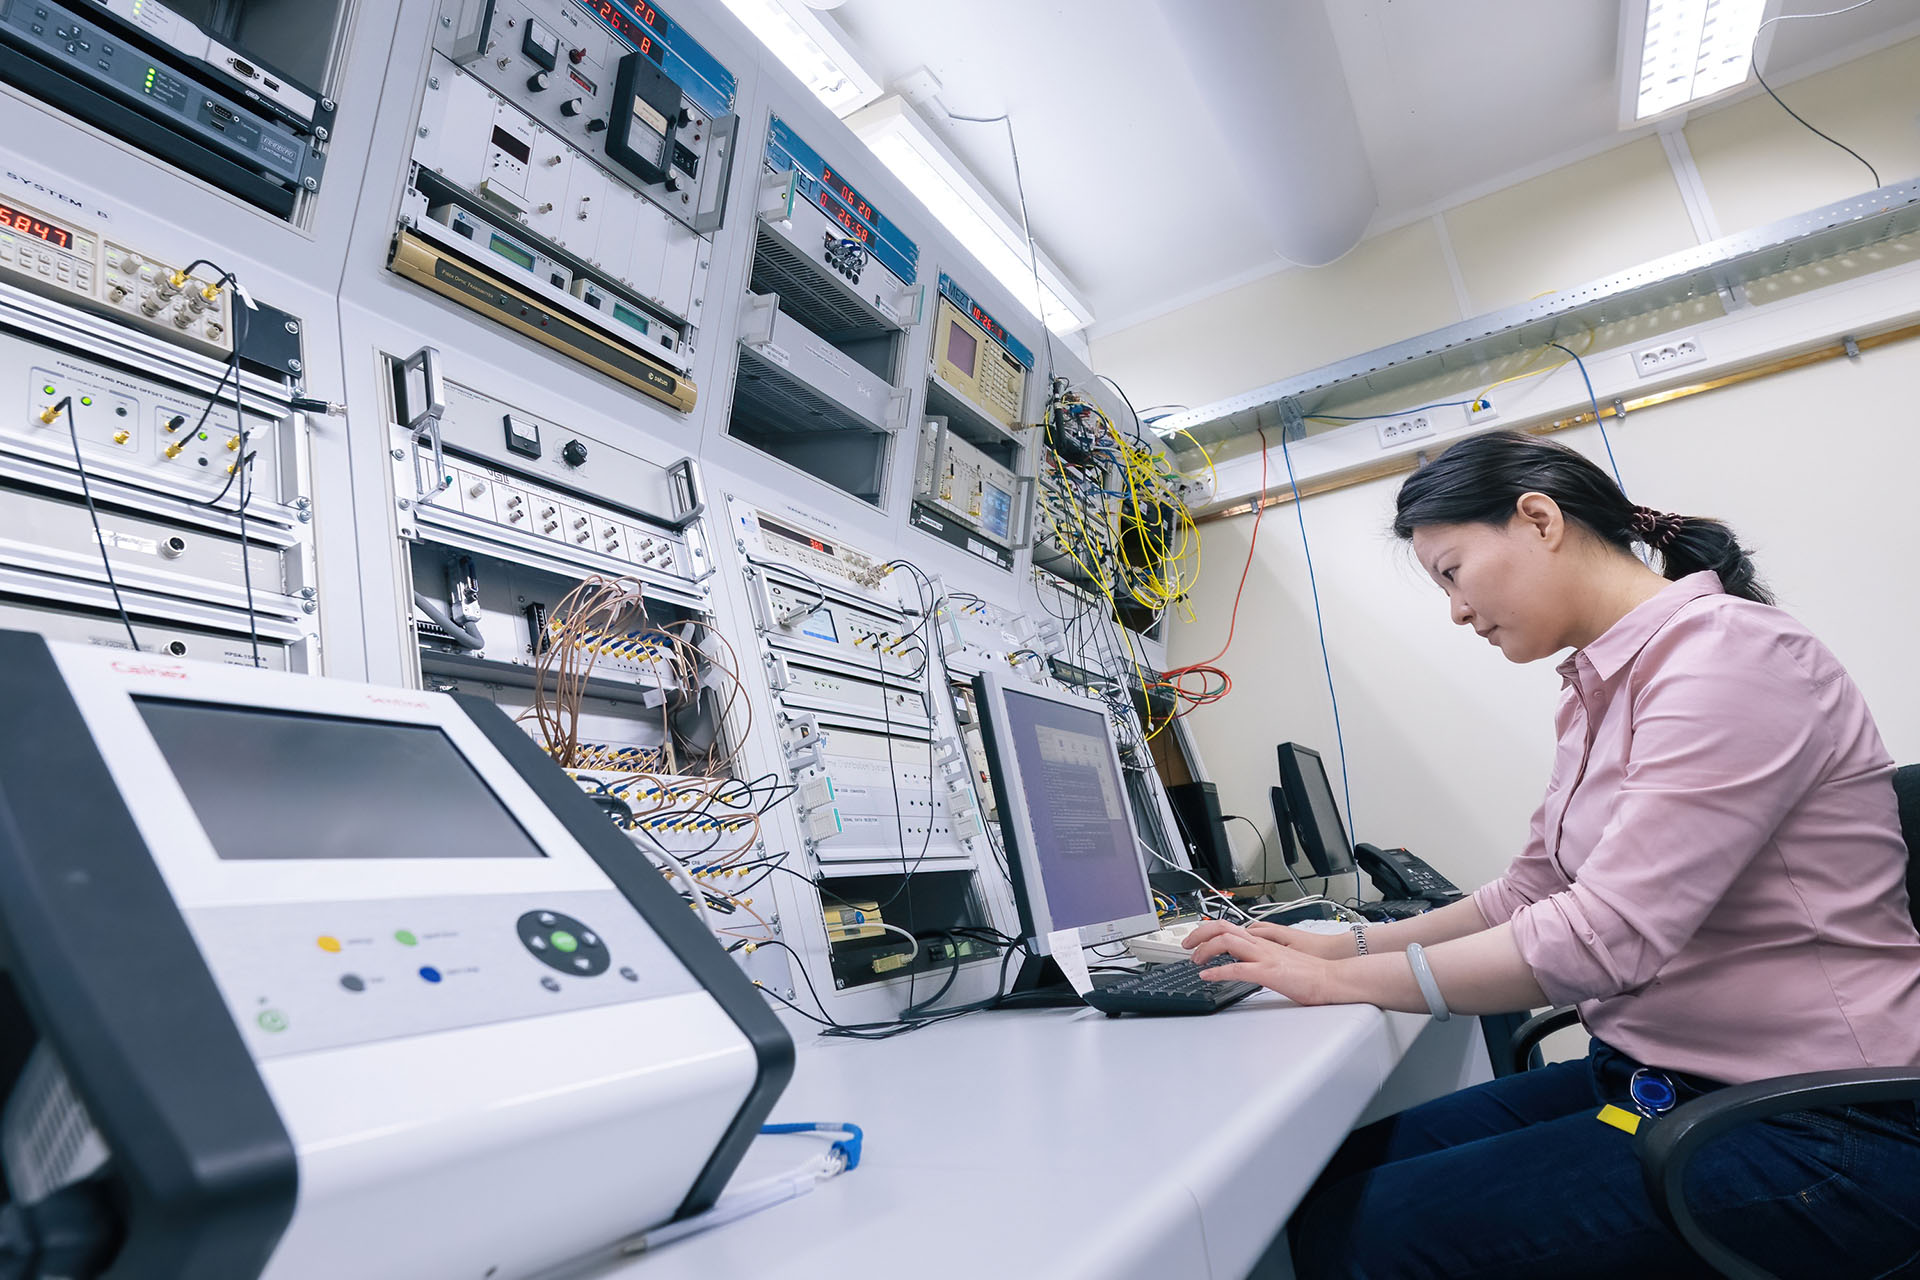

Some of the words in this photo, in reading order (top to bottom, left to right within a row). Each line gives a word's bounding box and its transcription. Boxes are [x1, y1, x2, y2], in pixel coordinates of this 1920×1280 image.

[634, 0, 655, 26] 20
[641, 37, 651, 54] 8
[7, 172, 82, 207] SYSTEM
[823, 167, 832, 183] 2
[841, 186, 855, 205] 06
[858, 202, 872, 221] 20
[0, 207, 67, 248] 5847
[820, 192, 828, 207] 0
[838, 209, 869, 242] 26:58
[56, 361, 99, 377] FREQUENCY
[101, 375, 115, 383] AND
[116, 380, 137, 391] PHASE
[139, 387, 163, 399] OFFSET
[164, 395, 201, 410] GENERATOR
